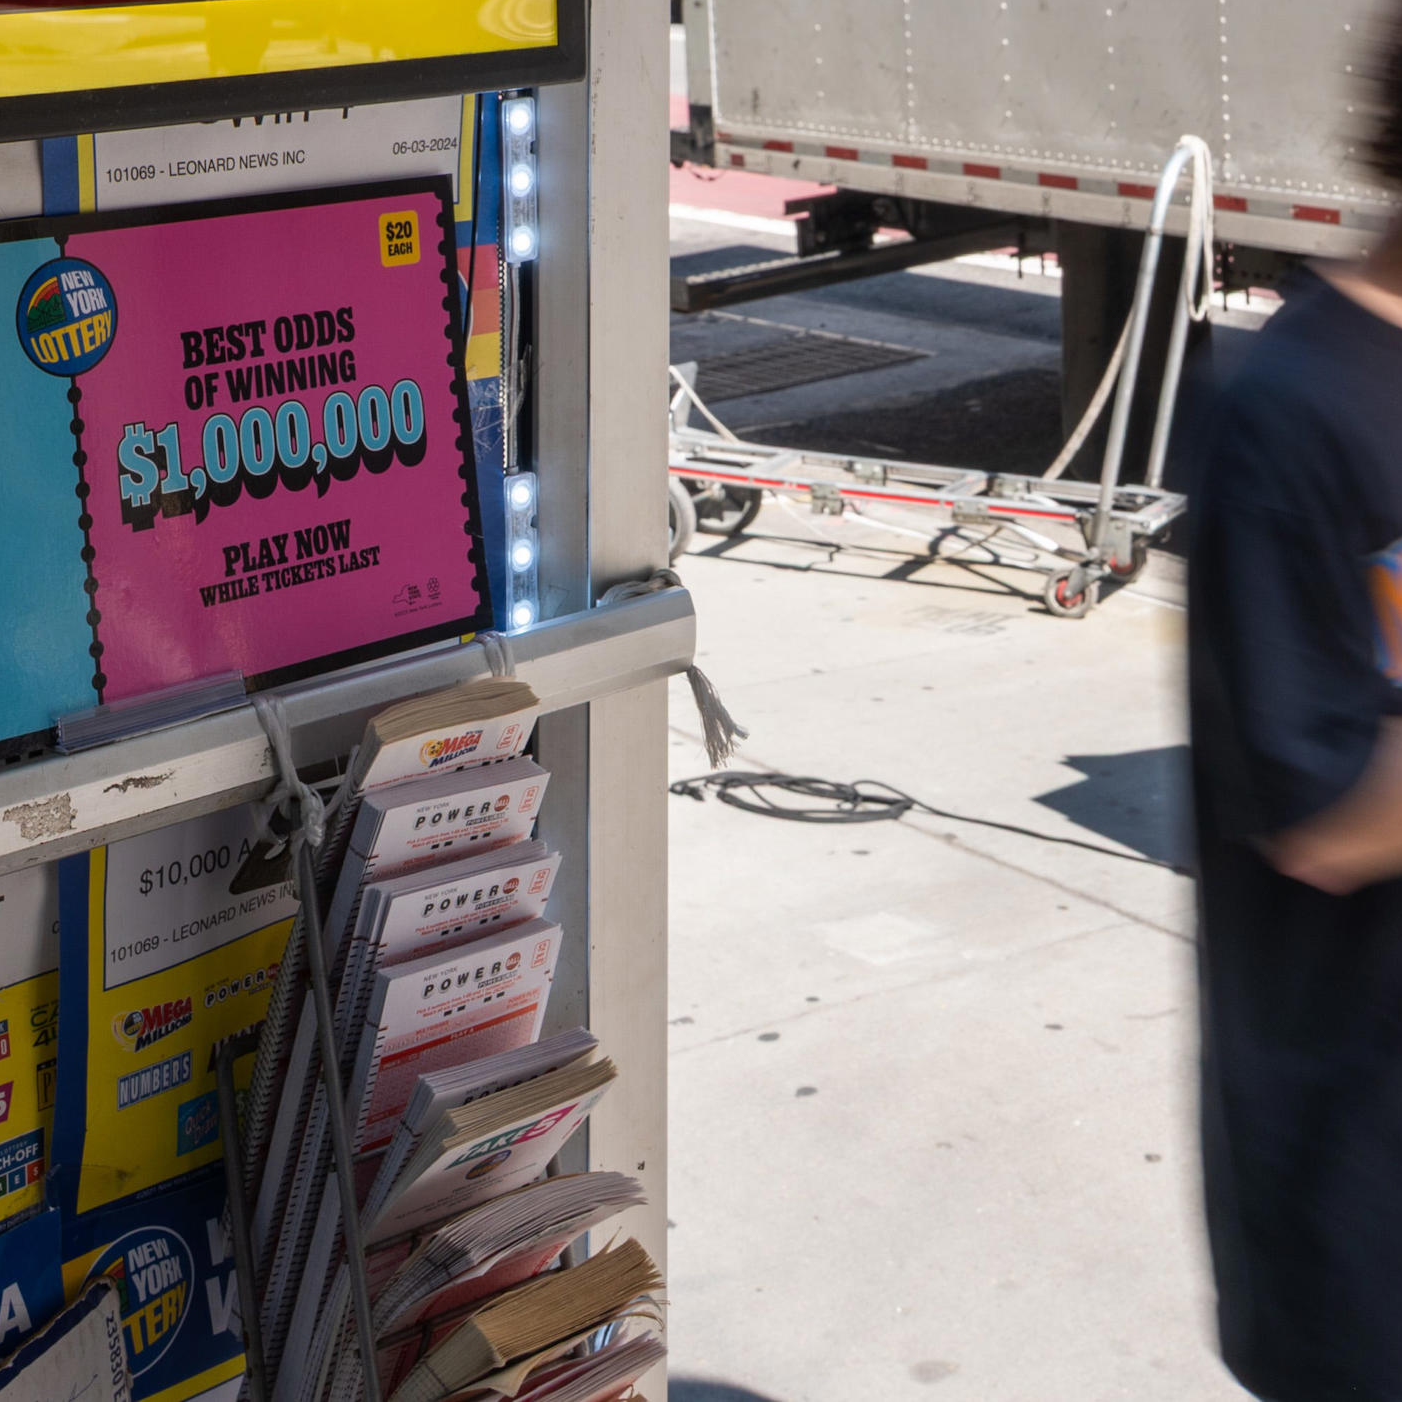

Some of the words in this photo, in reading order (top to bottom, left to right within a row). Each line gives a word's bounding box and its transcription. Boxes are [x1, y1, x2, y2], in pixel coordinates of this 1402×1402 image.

[105, 164, 156, 184] 101069
[168, 155, 236, 178] LEONARD
[239, 151, 279, 170] NEWS
[282, 149, 306, 166] INC
[392, 136, 459, 157] 06-03-2024
[385, 219, 413, 242] $20
[387, 241, 413, 258] EACH
[61, 269, 95, 299] NEW
[64, 286, 109, 321] YORK
[28, 314, 114, 368] LOTTERY
[178, 324, 266, 371] BEST
[272, 306, 356, 355] ODDS
[183, 375, 219, 411] OF
[224, 348, 357, 404] WINNING
[117, 379, 427, 526] $1,000,000
[222, 533, 289, 578] PLAY
[293, 518, 351, 561] NOW
[199, 574, 260, 608] WHILE
[262, 556, 336, 594] TICKETS
[338, 545, 380, 575] LAST
[428, 745, 478, 768] MILLIONS
[437, 731, 484, 756] MEGA
[139, 844, 232, 897] $10,000
[110, 934, 161, 965] 101069
[172, 906, 237, 944] LEONARD
[238, 888, 277, 916] NEWS
[134, 1013, 193, 1053] MILLIONS
[140, 996, 193, 1036] MEGA
[119, 1054, 191, 1109] NUMBERS
[127, 1237, 171, 1273] NEW
[131, 1255, 184, 1303] YORK
